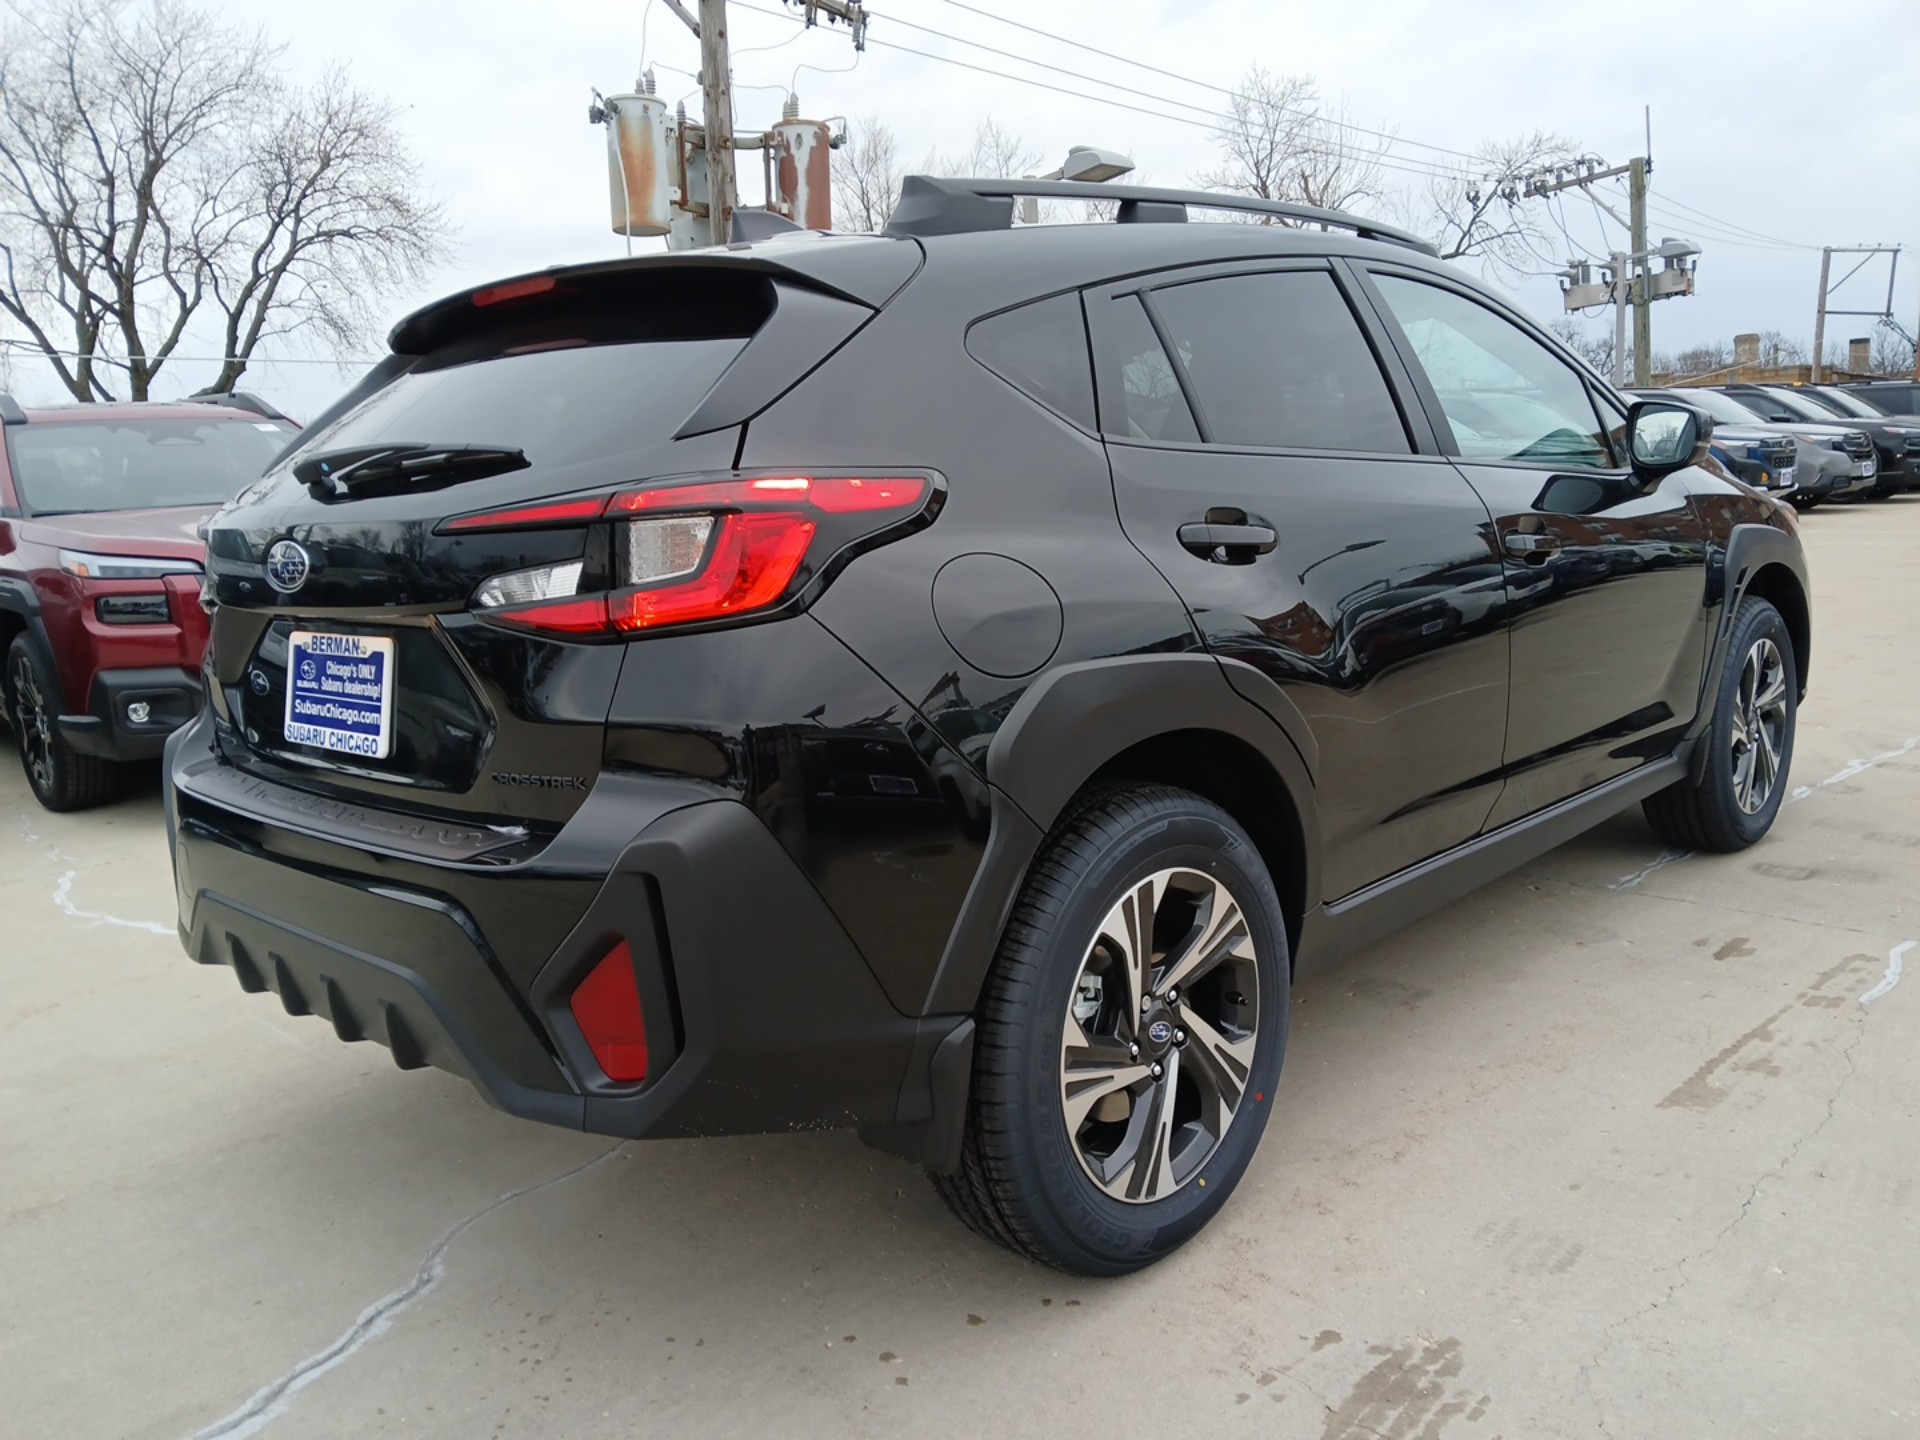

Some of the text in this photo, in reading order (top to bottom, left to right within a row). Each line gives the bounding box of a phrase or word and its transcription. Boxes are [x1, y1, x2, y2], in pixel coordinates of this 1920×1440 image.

[311, 635, 360, 656] BERMAN
[326, 660, 376, 680] Chicago's ONLY
[321, 676, 381, 700] Subaru dealership!
[294, 699, 381, 725] SubaruChicago.com
[286, 724, 378, 755] SUBARU CHICAGO
[491, 771, 588, 791] CROSSTREK
